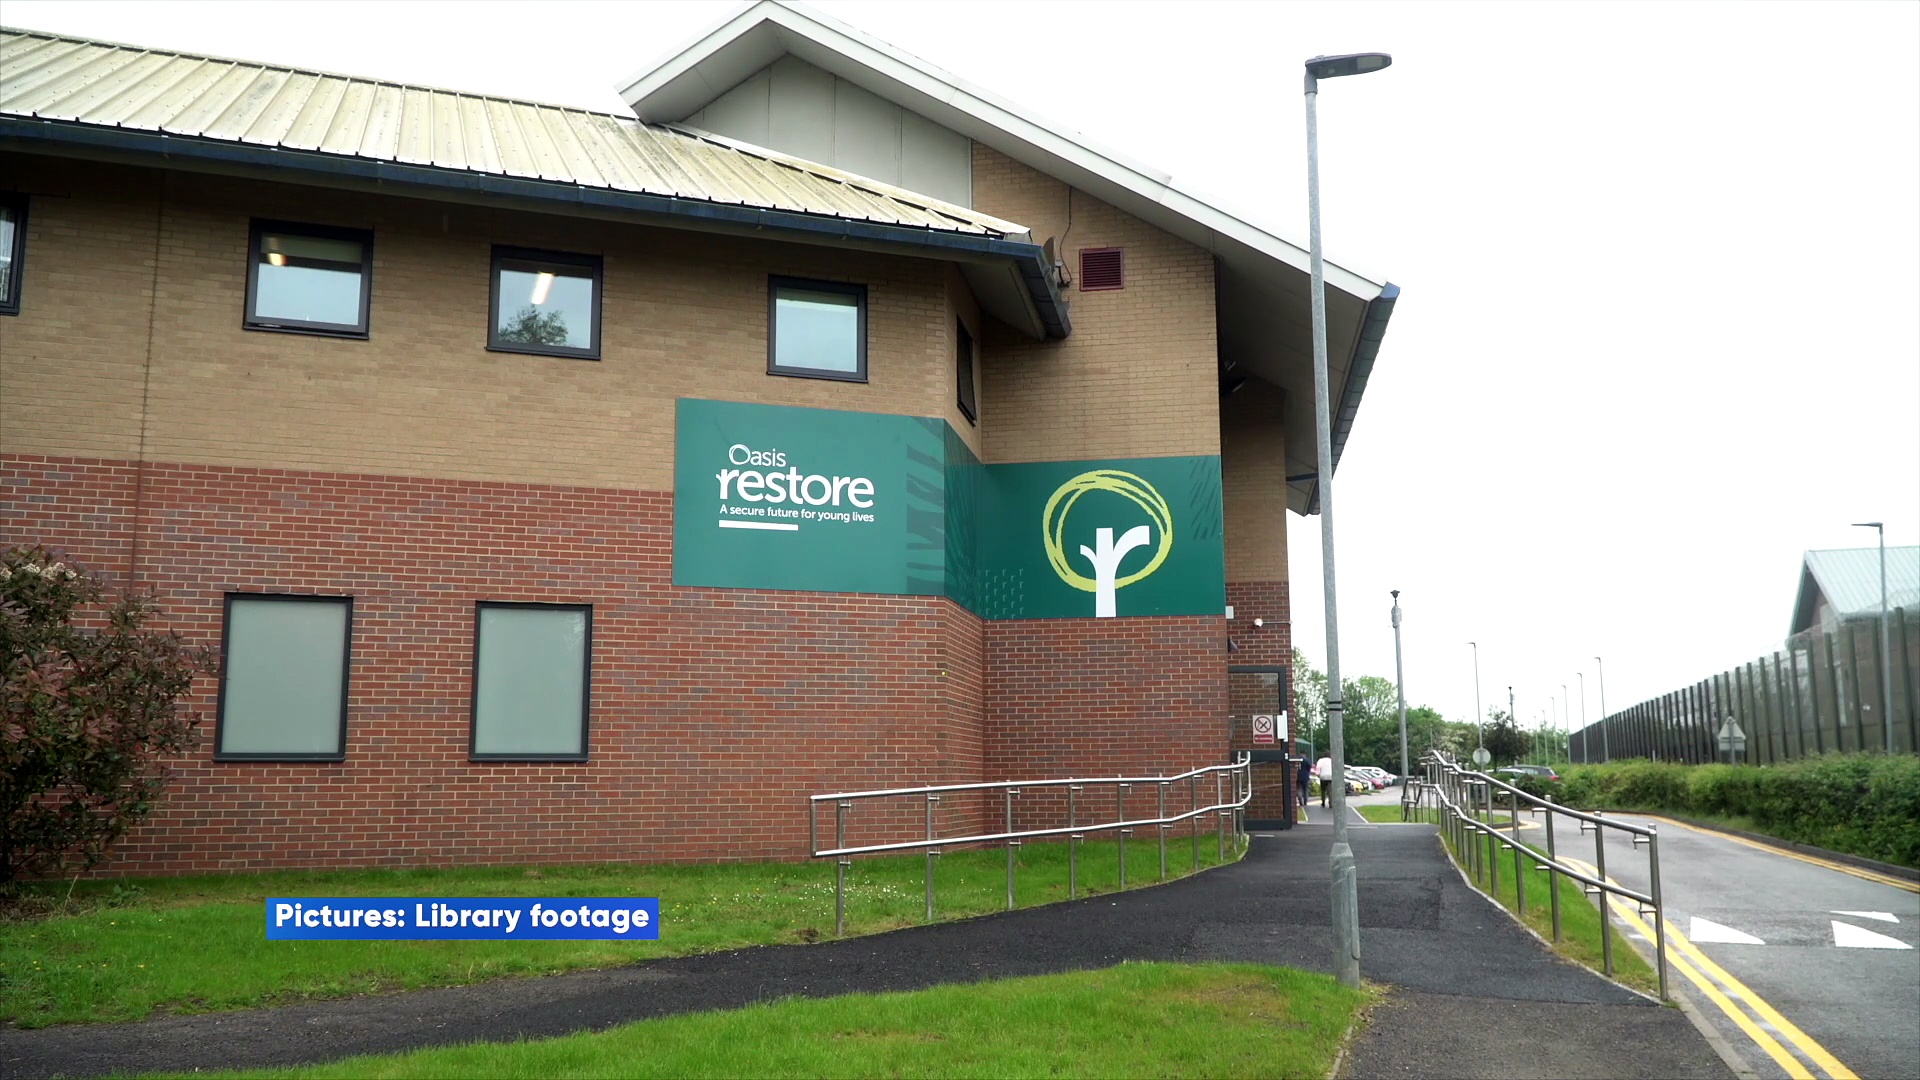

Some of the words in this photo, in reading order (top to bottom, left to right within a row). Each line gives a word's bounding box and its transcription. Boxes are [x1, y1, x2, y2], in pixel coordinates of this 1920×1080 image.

[729, 443, 787, 467] Oasis
[716, 466, 875, 508] restore
[719, 504, 728, 514] A
[730, 506, 765, 516] secure
[767, 506, 799, 518] future
[801, 509, 817, 519] for
[818, 511, 850, 523] young
[852, 511, 875, 522] lives
